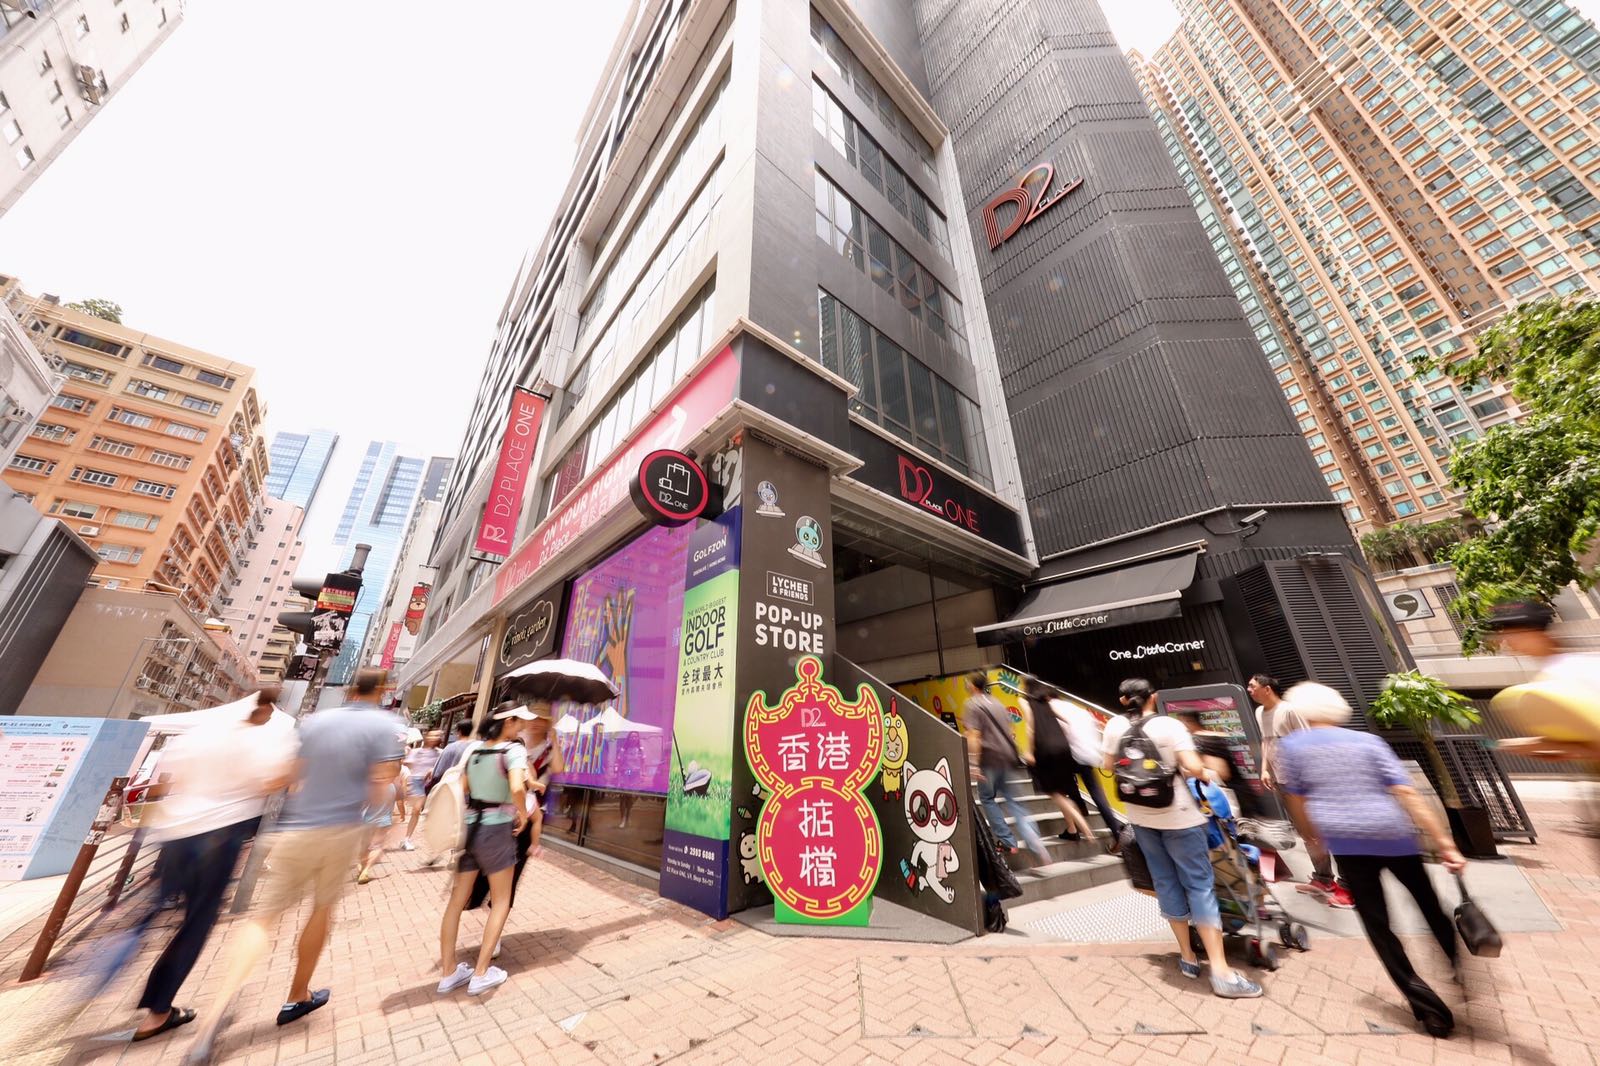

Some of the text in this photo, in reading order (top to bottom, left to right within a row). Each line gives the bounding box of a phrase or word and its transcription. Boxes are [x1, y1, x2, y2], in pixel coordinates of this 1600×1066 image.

[982, 162, 1084, 252] D2
[494, 402, 536, 517] D2 PLACE ONE
[543, 521, 558, 546] ON
[560, 491, 590, 532] YOUR
[591, 450, 634, 499] RIGHT
[659, 491, 688, 510] D2 ONE
[898, 454, 980, 533] D2 ONE
[693, 534, 727, 562] GOLFZON
[772, 576, 808, 593] LYCHEE
[772, 586, 808, 601] & FRIENDS
[686, 606, 726, 634] INDOOR
[755, 601, 823, 630] POP-UP
[684, 622, 726, 656] GOLF
[755, 623, 824, 654] STORE
[1023, 625, 1043, 636] One
[687, 653, 709, 666] COUNTRY
[710, 648, 725, 660] CLUB
[1109, 648, 1132, 661] One
[682, 662, 724, 686] 全球最大
[801, 707, 827, 728] D2
[778, 731, 851, 772] 香港
